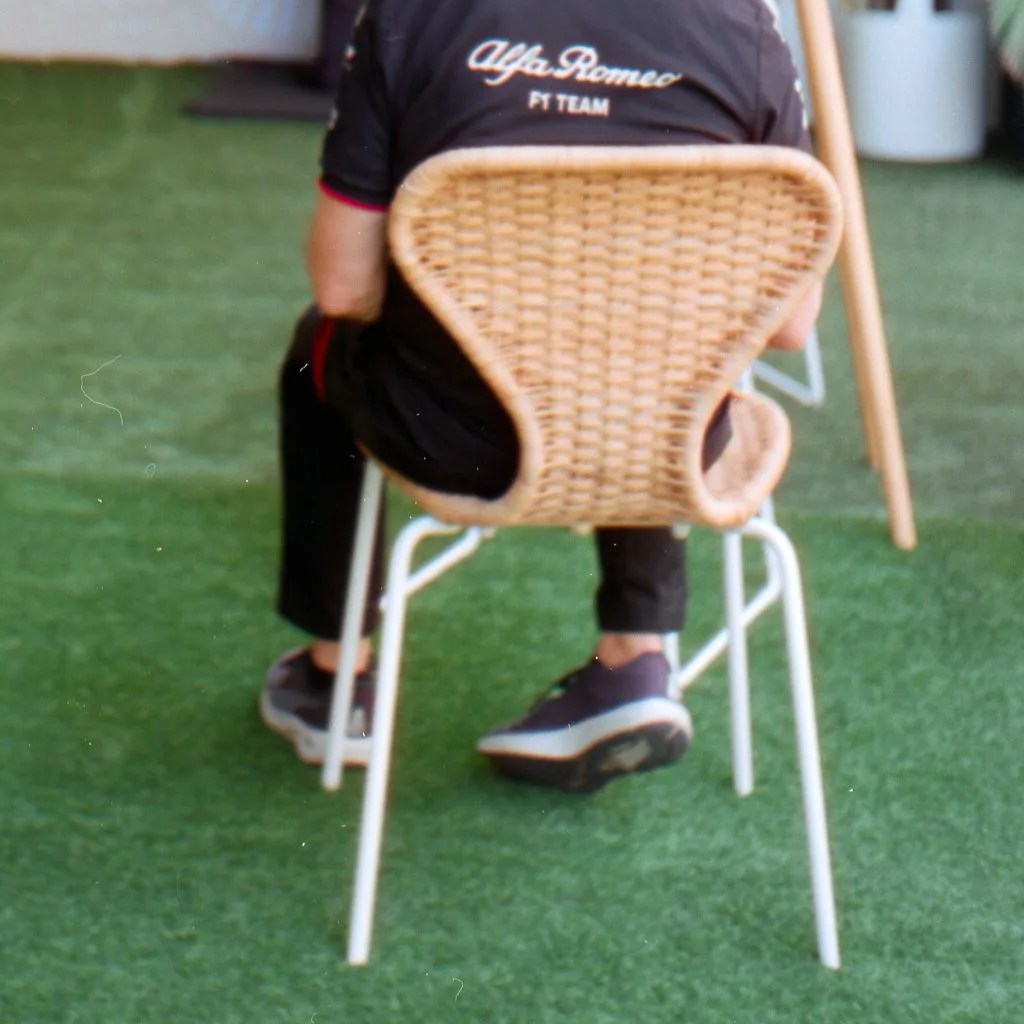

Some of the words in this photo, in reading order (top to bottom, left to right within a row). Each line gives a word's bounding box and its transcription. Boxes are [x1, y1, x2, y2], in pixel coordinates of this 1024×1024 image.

[467, 39, 554, 86] Alfa
[553, 45, 682, 88] Romeo
[529, 90, 552, 112] F1
[556, 93, 610, 116] TEAM
